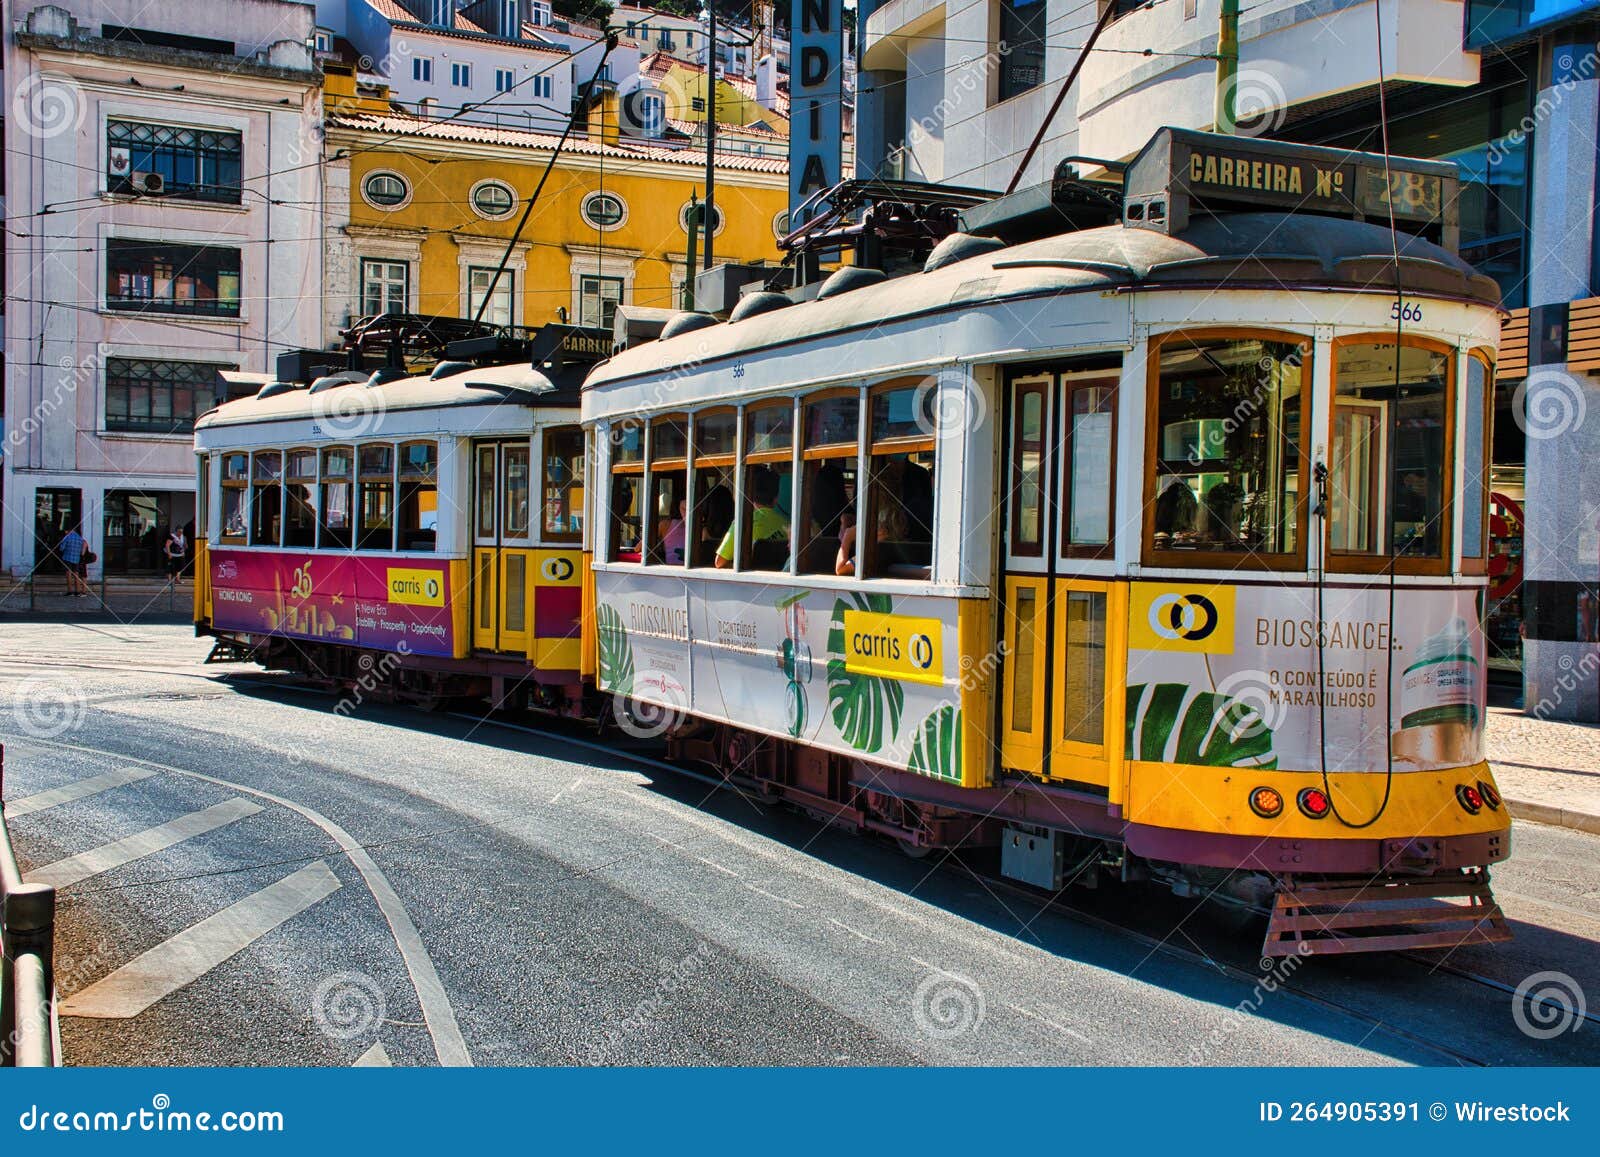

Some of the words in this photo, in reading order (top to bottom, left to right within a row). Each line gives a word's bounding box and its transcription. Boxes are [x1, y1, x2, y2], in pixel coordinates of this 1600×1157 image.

[799, 0, 830, 226] NDIA
[1190, 152, 1302, 194] CARREIRA
[1391, 302, 1422, 322] 566
[392, 576, 420, 594] carris
[236, 591, 252, 603] KONG
[361, 603, 375, 614] New
[376, 603, 388, 616] Era
[380, 618, 407, 635] Prosperity
[410, 622, 447, 639] Opportunity
[853, 627, 900, 660] carris
[1270, 670, 1279, 685] O
[1369, 669, 1377, 688] É
